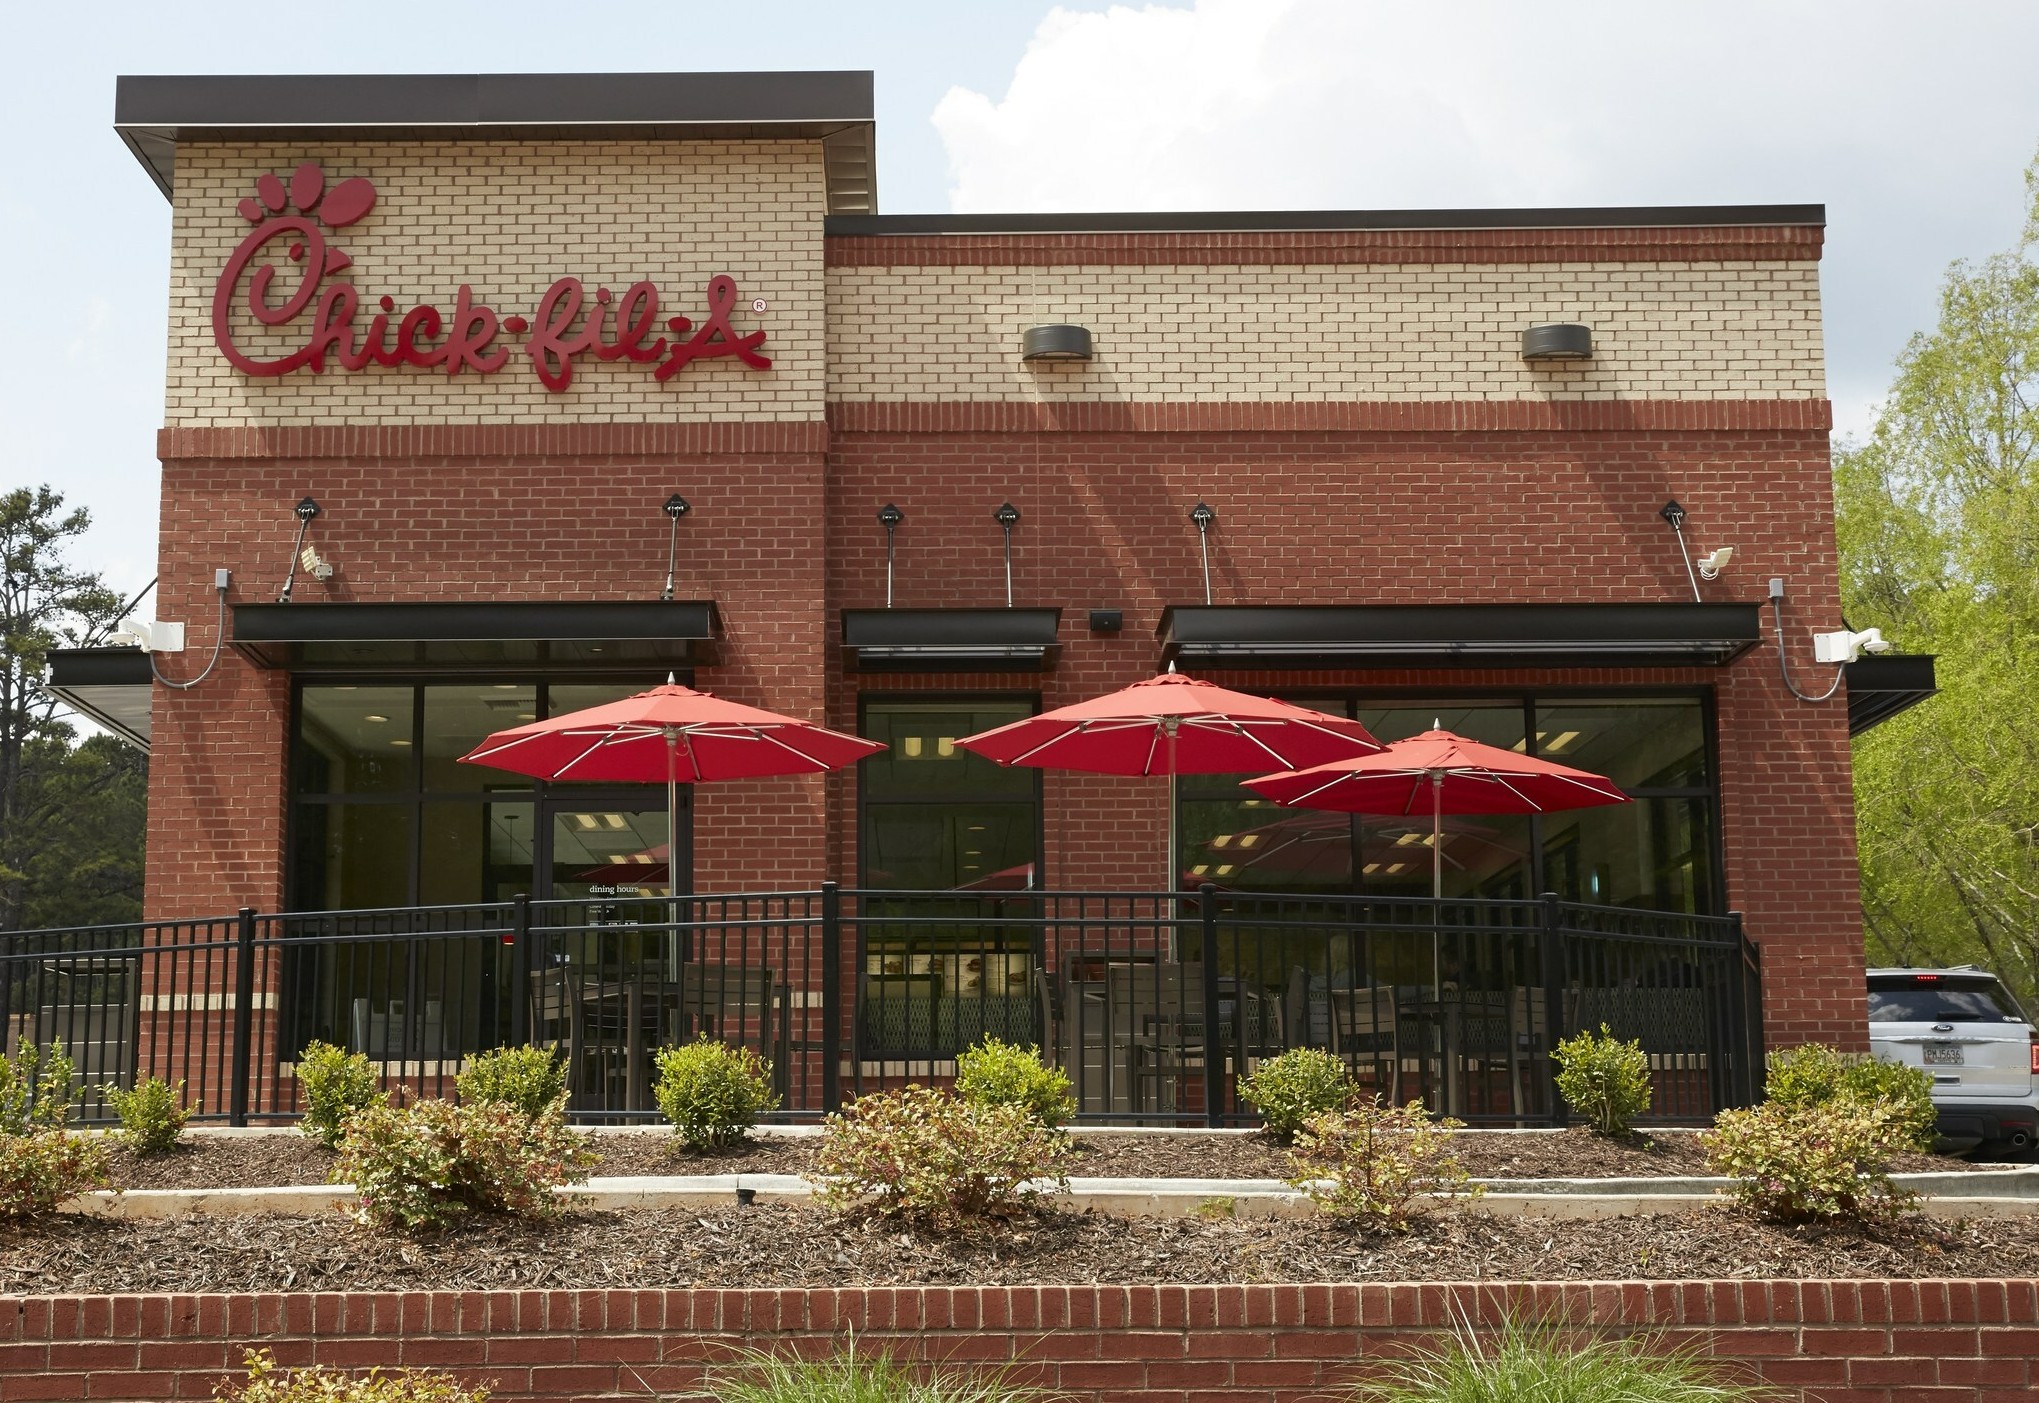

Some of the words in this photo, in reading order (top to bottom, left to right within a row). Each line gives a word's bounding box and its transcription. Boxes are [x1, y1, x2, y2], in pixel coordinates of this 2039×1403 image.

[212, 214, 773, 393] Chick-fil-A
[589, 885, 615, 894] dining
[616, 885, 639, 893] hours
[1926, 1049, 1961, 1060] PMJ5636
